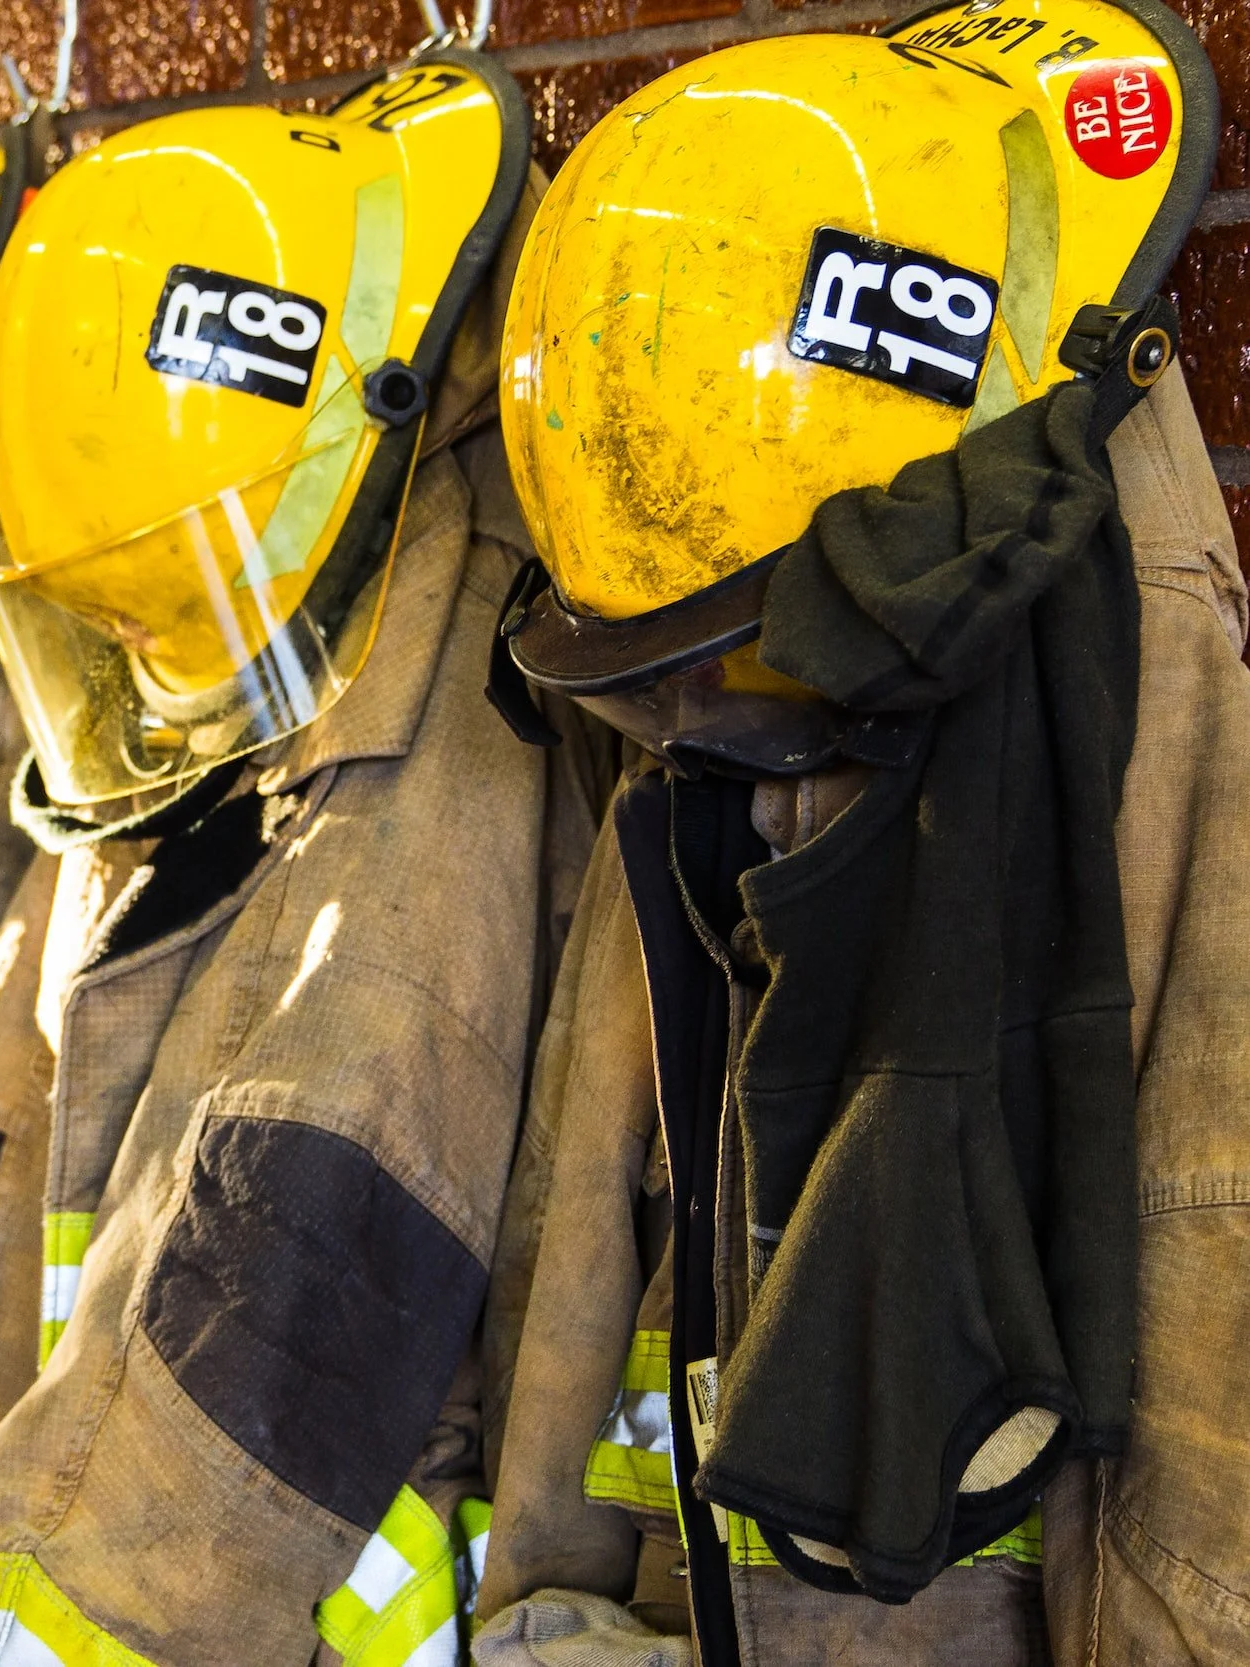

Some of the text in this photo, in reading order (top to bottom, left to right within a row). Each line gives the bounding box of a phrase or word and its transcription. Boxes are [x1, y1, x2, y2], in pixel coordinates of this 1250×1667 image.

[1073, 96, 1111, 143] BE
[1113, 72, 1157, 155] NICE
[156, 282, 227, 365] R
[216, 291, 322, 386] 18
[808, 251, 887, 353] R
[877, 264, 993, 380] 18
